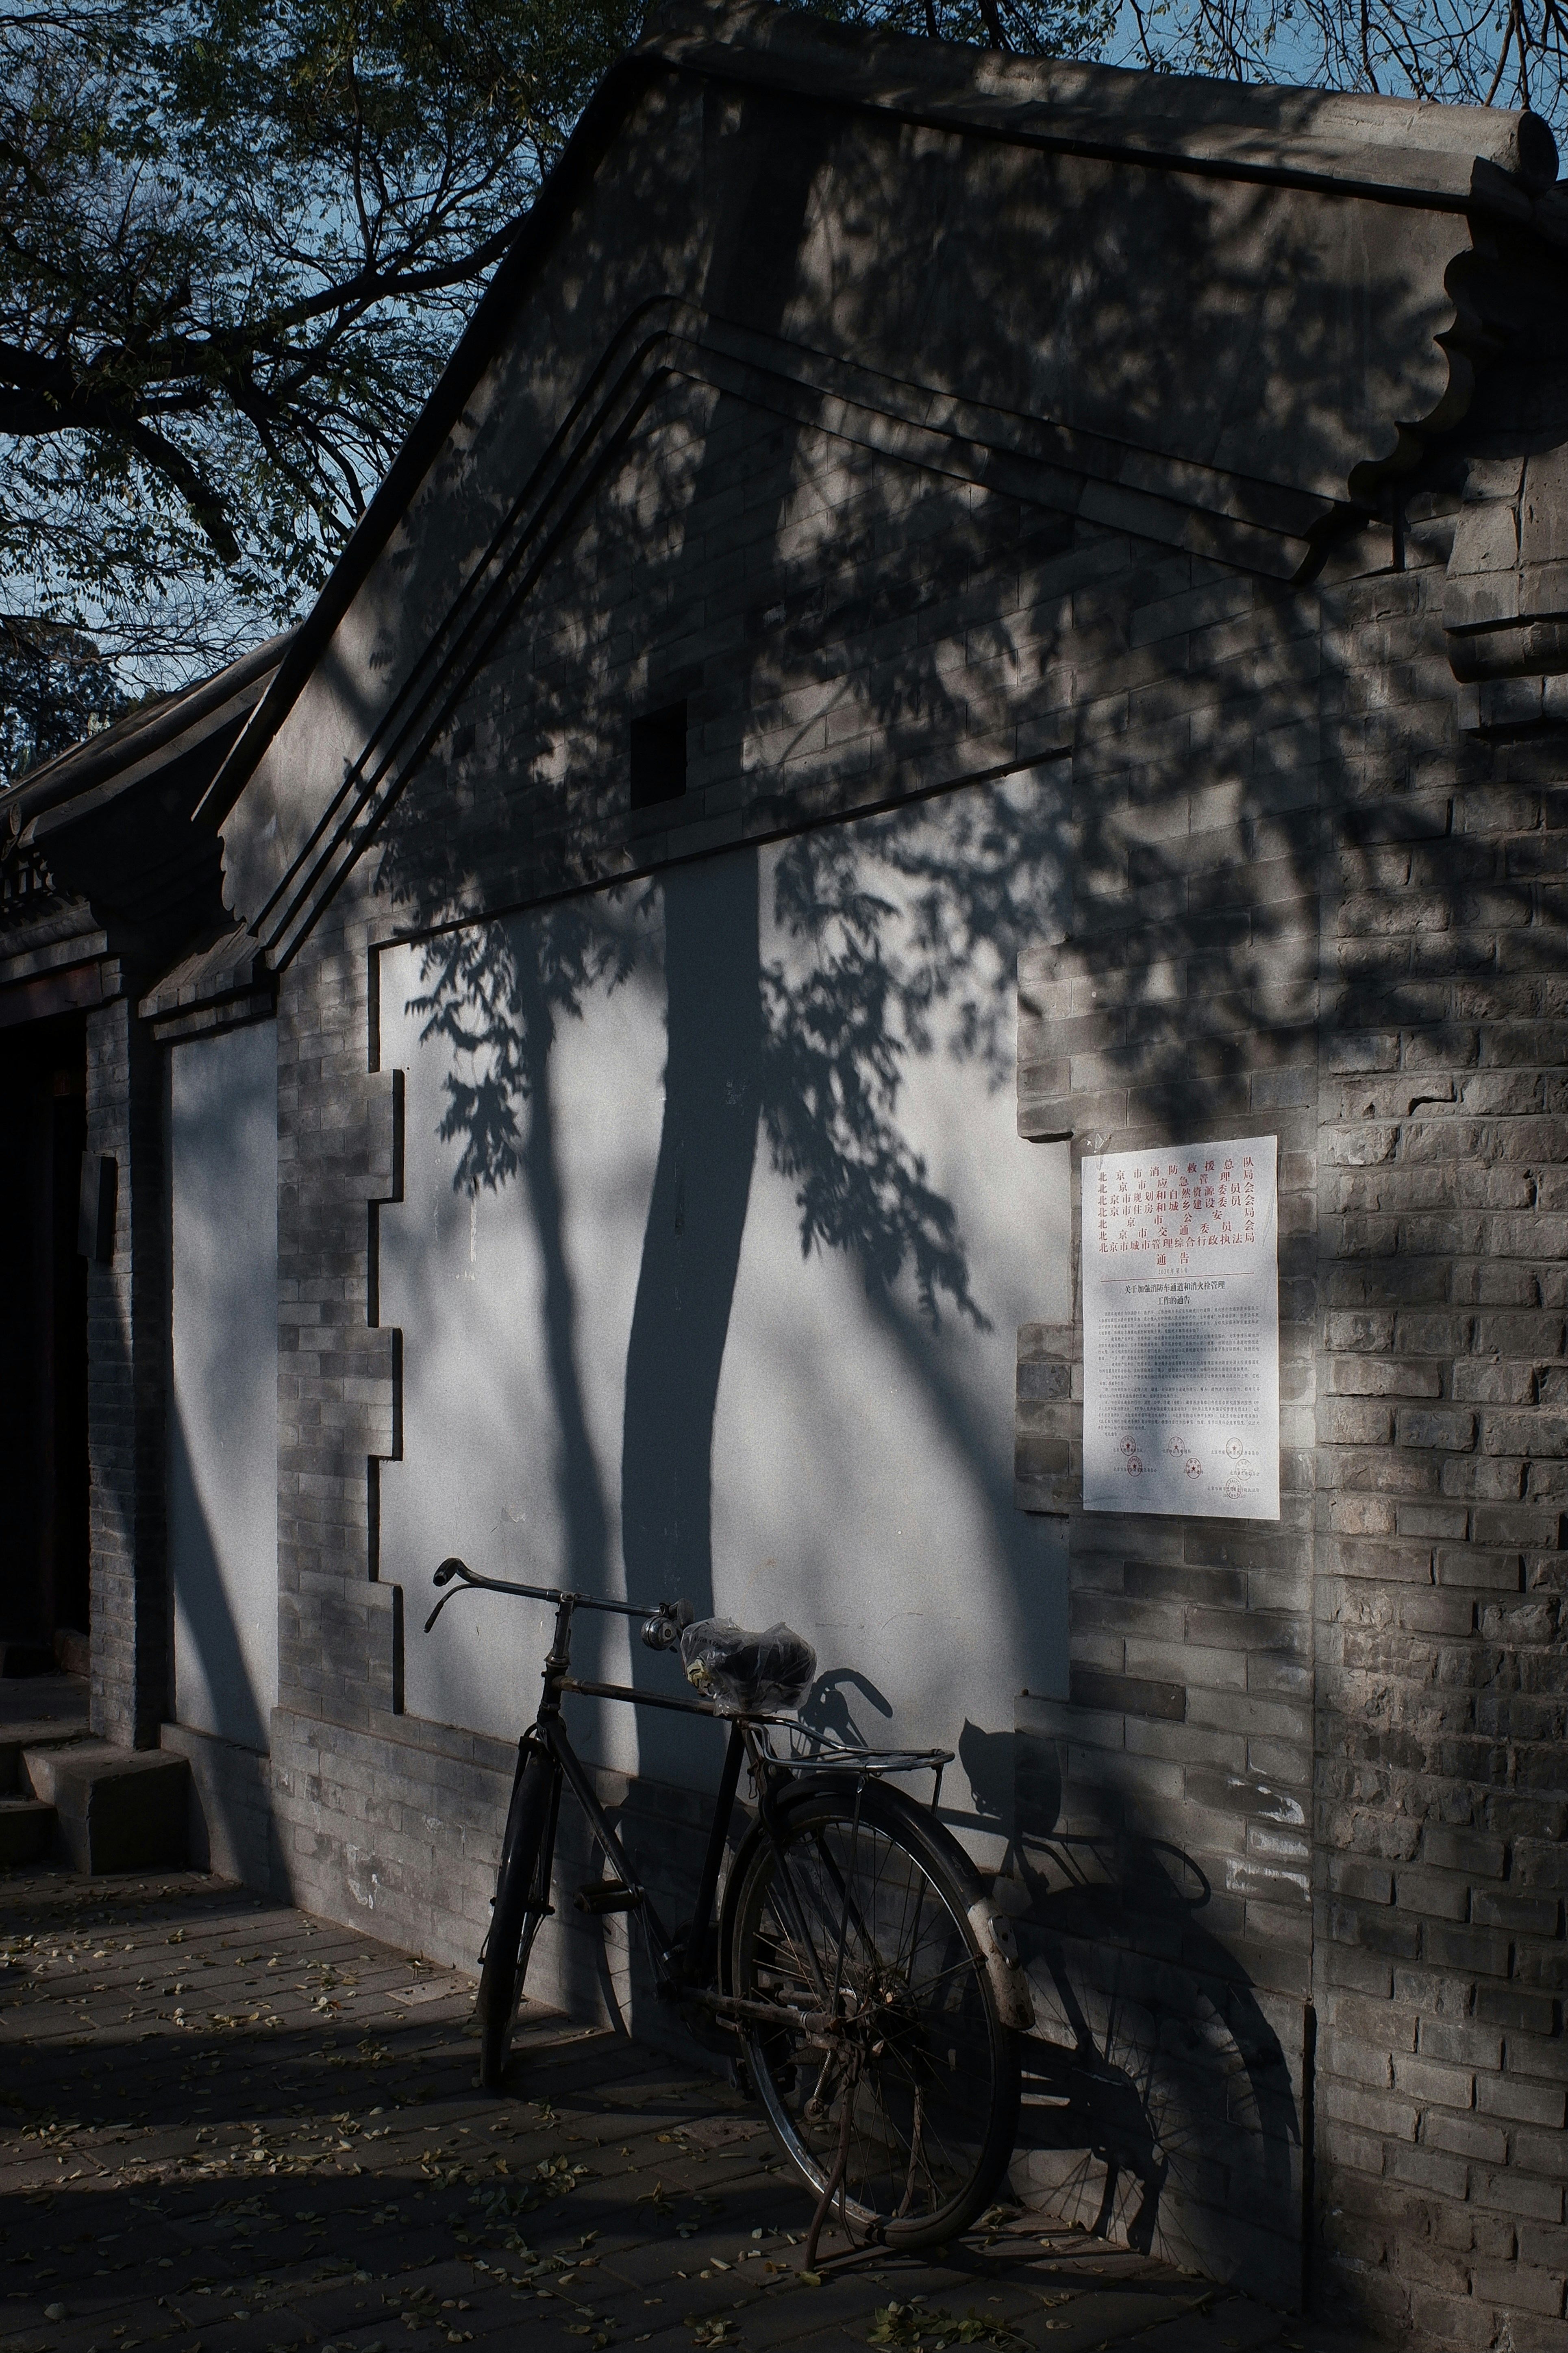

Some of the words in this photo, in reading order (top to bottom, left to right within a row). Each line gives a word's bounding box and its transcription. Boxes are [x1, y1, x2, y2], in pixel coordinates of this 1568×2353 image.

[1098, 1156, 1254, 1182] 北京市消防救援总队
[1098, 1169, 1254, 1194] 北京市应急管理局
[1098, 1182, 1255, 1206] 北京市规划和自然资源委员会
[1098, 1194, 1255, 1217] 北京市住房和城乡建设委员会
[1098, 1207, 1255, 1229] 北京市公安局
[1098, 1219, 1255, 1241] 北京市交通委员会
[1099, 1232, 1255, 1253] 北京市城市管理综合行政执法局
[1157, 1252, 1190, 1265] 通告
[1124, 1281, 1225, 1294] 关于加强消防车通道和消火栓管理
[1157, 1295, 1190, 1305] 工作的通告
